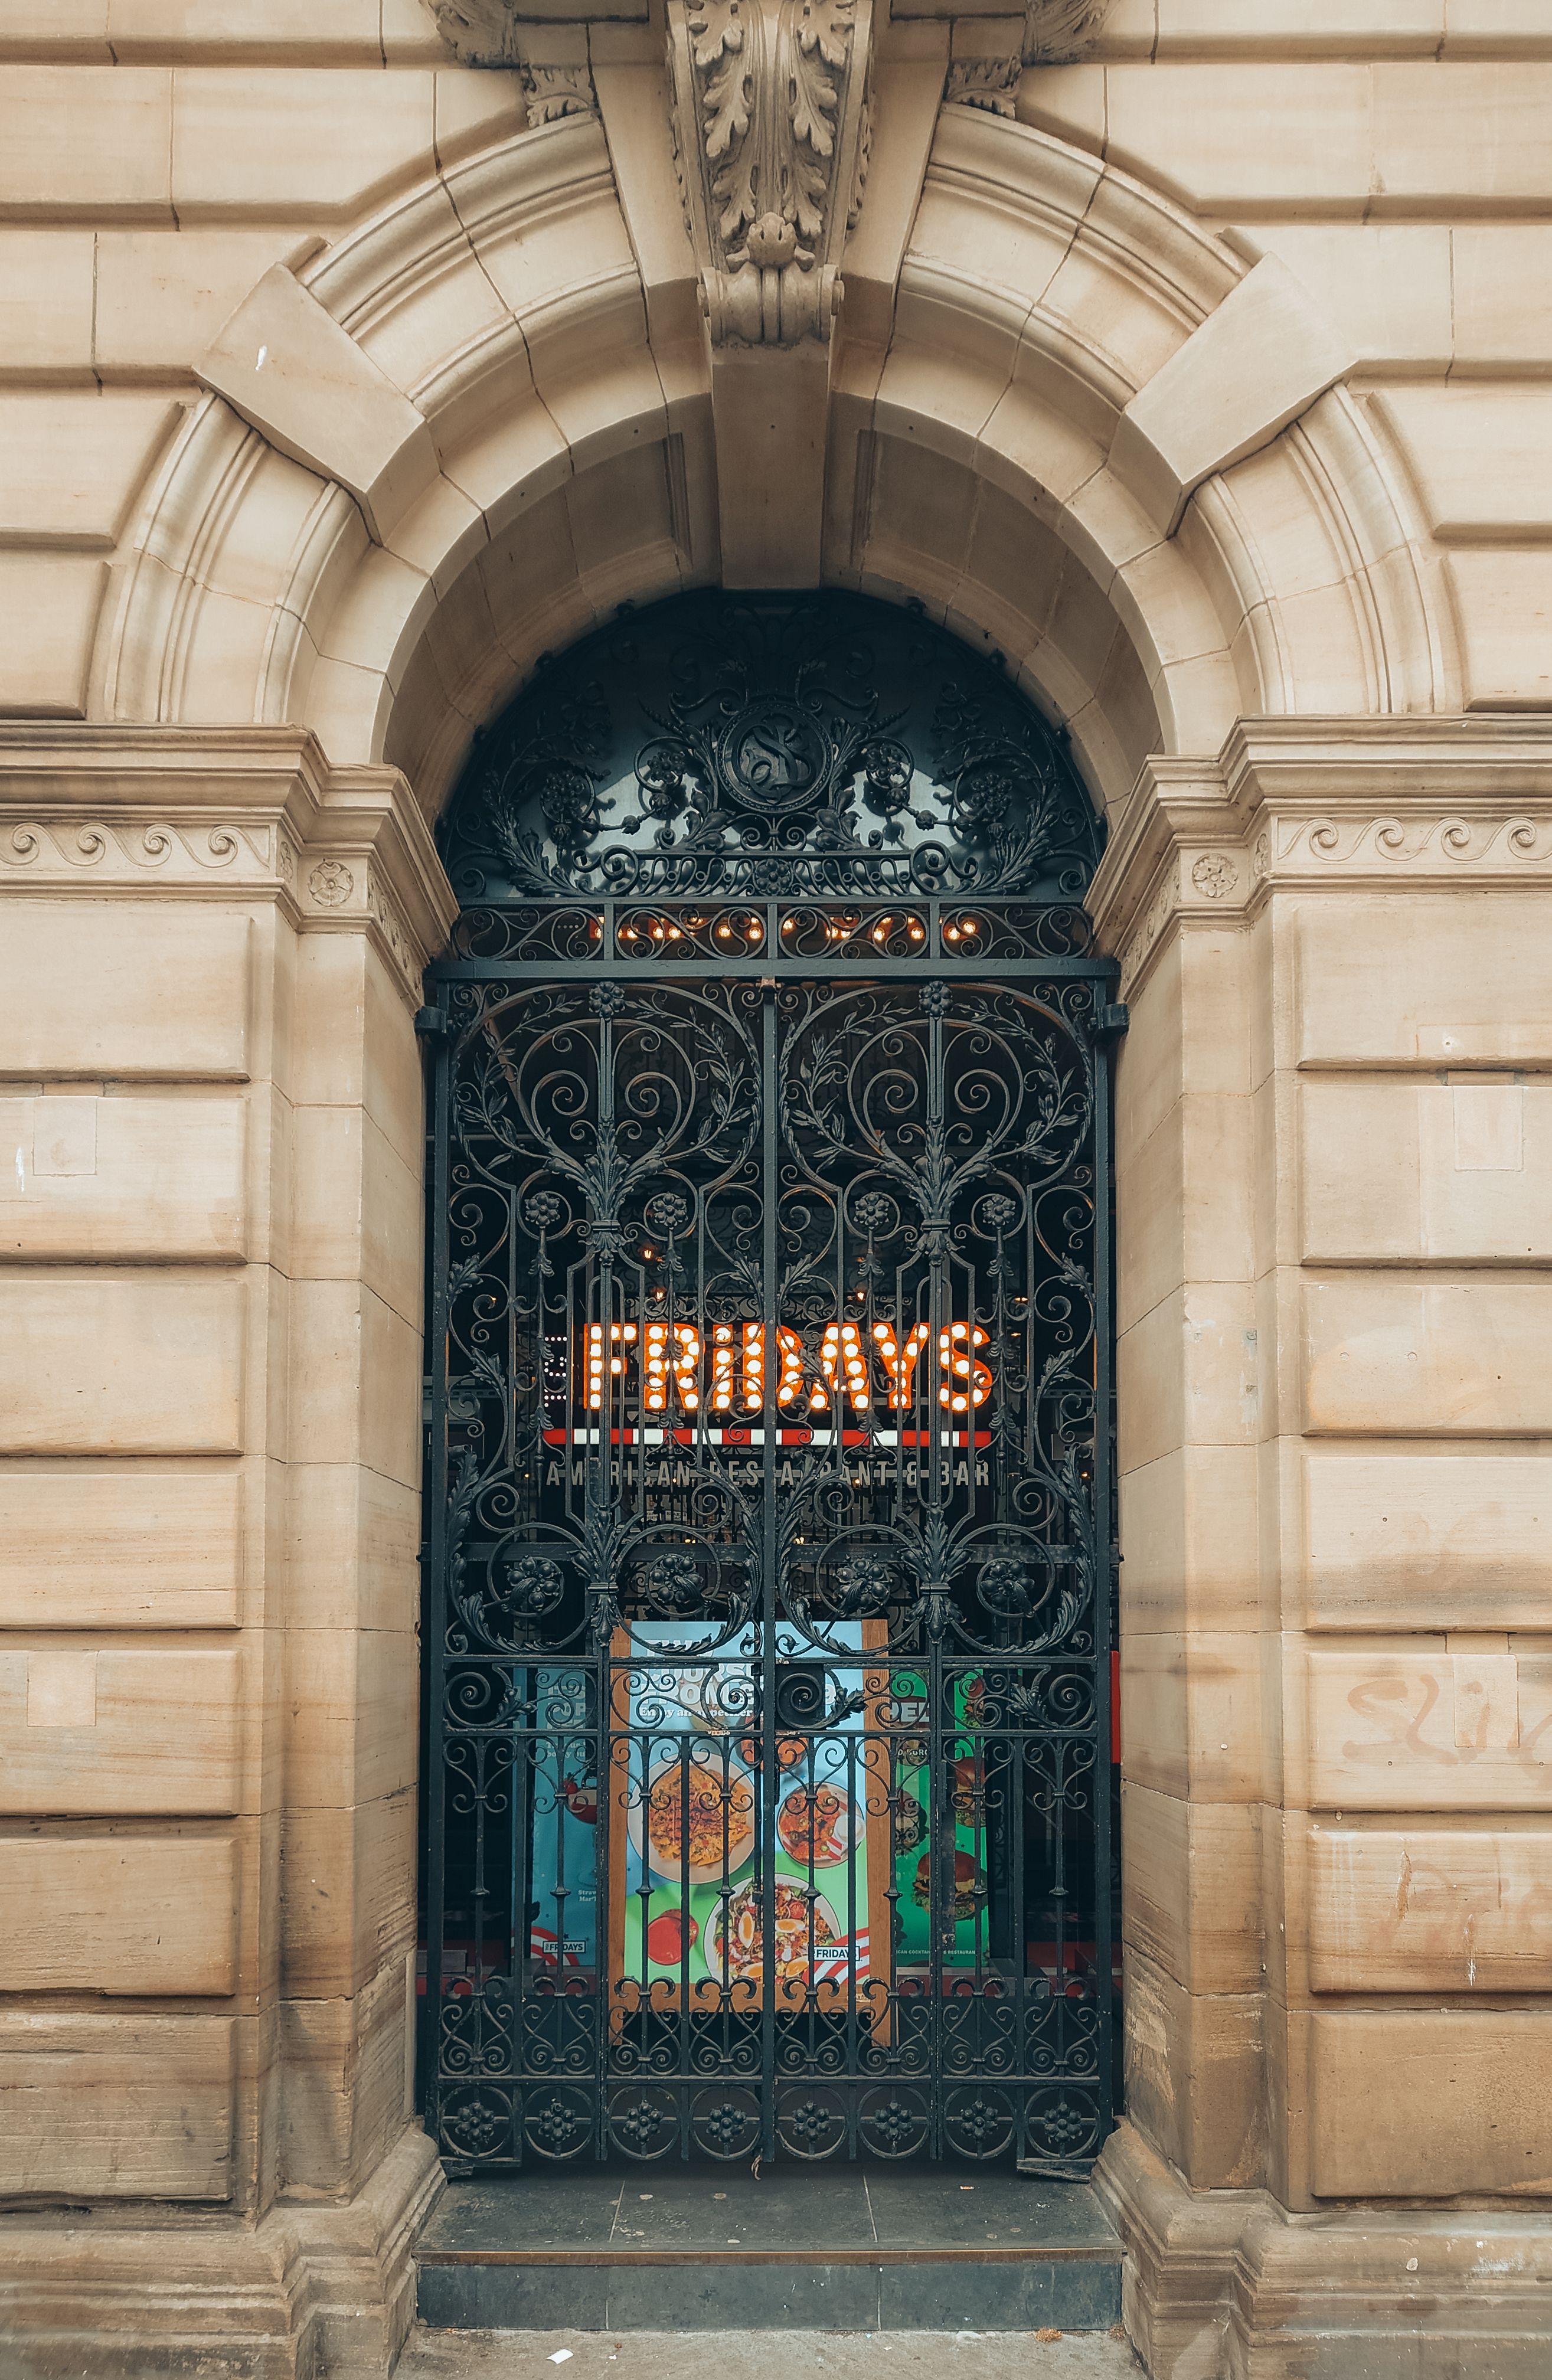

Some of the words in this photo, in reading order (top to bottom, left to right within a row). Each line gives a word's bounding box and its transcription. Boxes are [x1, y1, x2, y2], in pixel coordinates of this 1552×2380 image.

[546, 1461, 690, 1486] AMRIAN
[941, 1461, 989, 1486] BAR
[816, 1949, 856, 1958] FRIDAY
